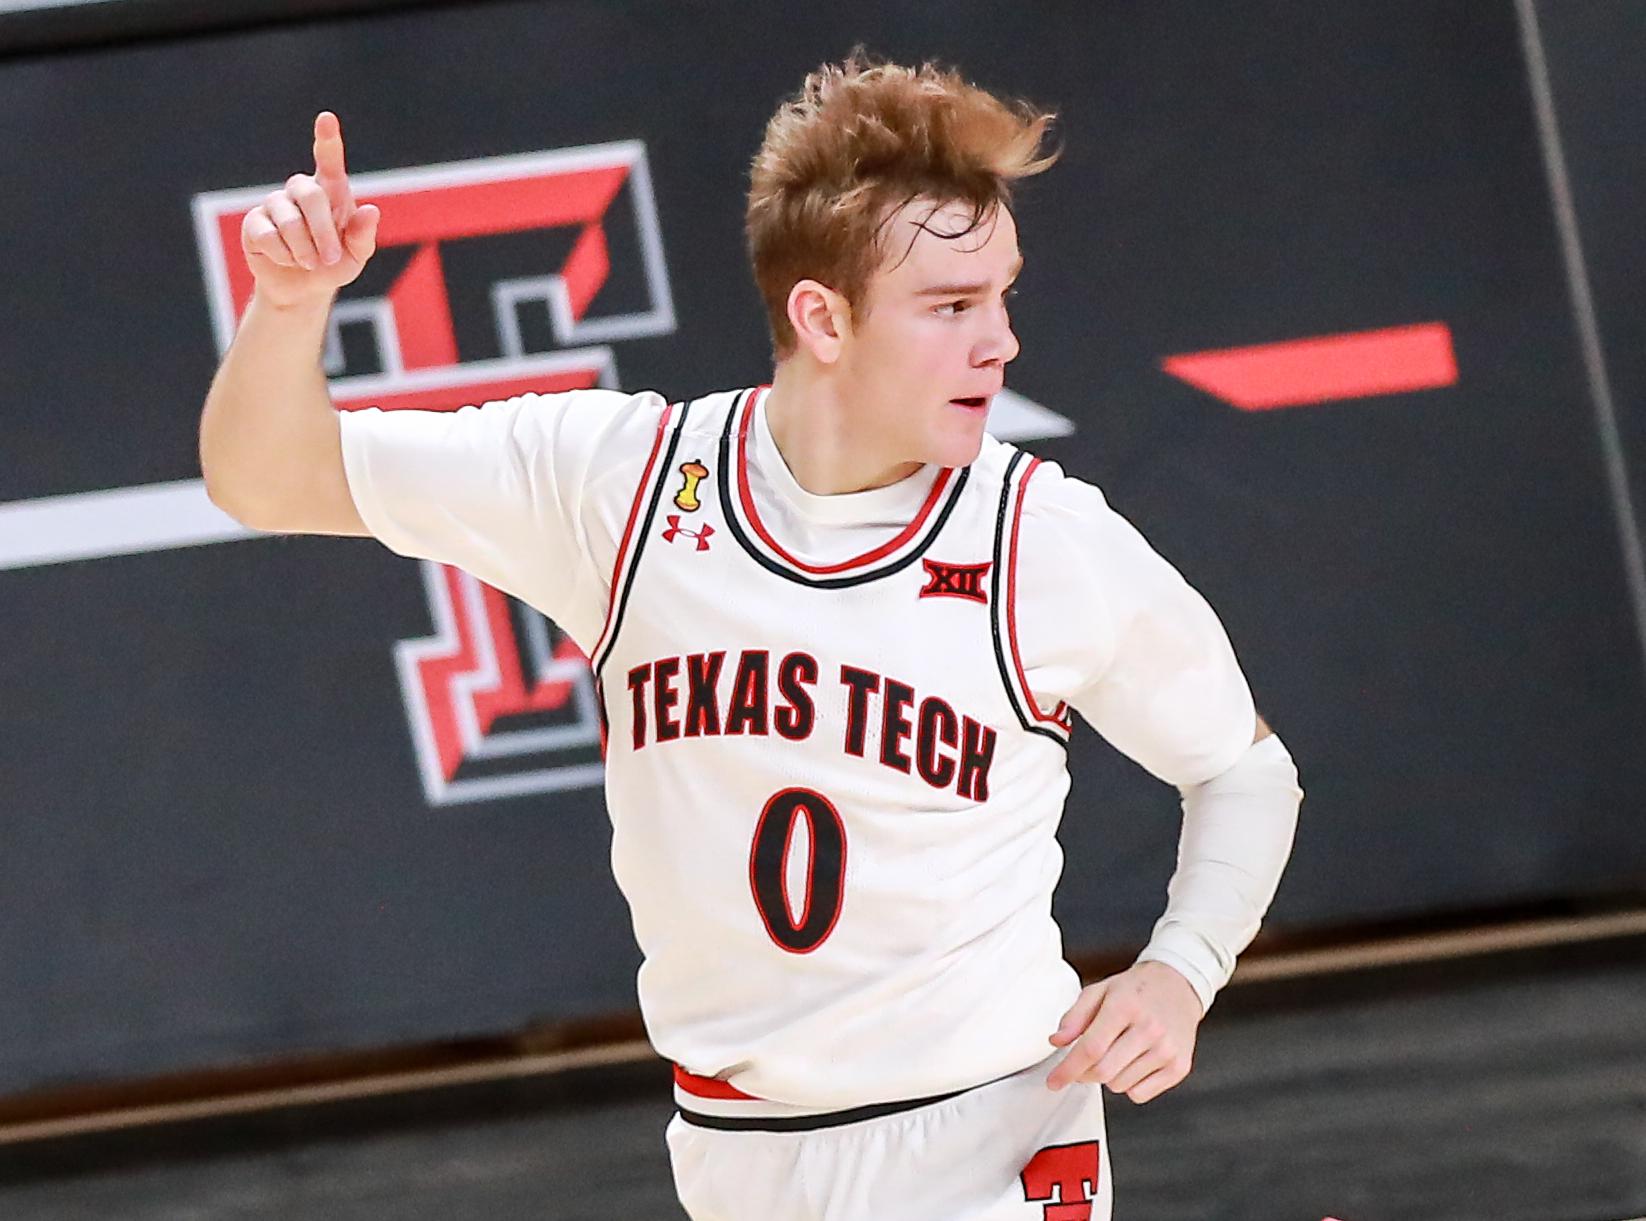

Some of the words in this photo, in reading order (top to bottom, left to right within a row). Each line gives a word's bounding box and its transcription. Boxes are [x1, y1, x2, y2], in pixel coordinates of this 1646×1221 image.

[924, 560, 987, 602] XII
[628, 650, 818, 751] TEXAS
[840, 664, 997, 803] TECH
[749, 787, 847, 954] 0
